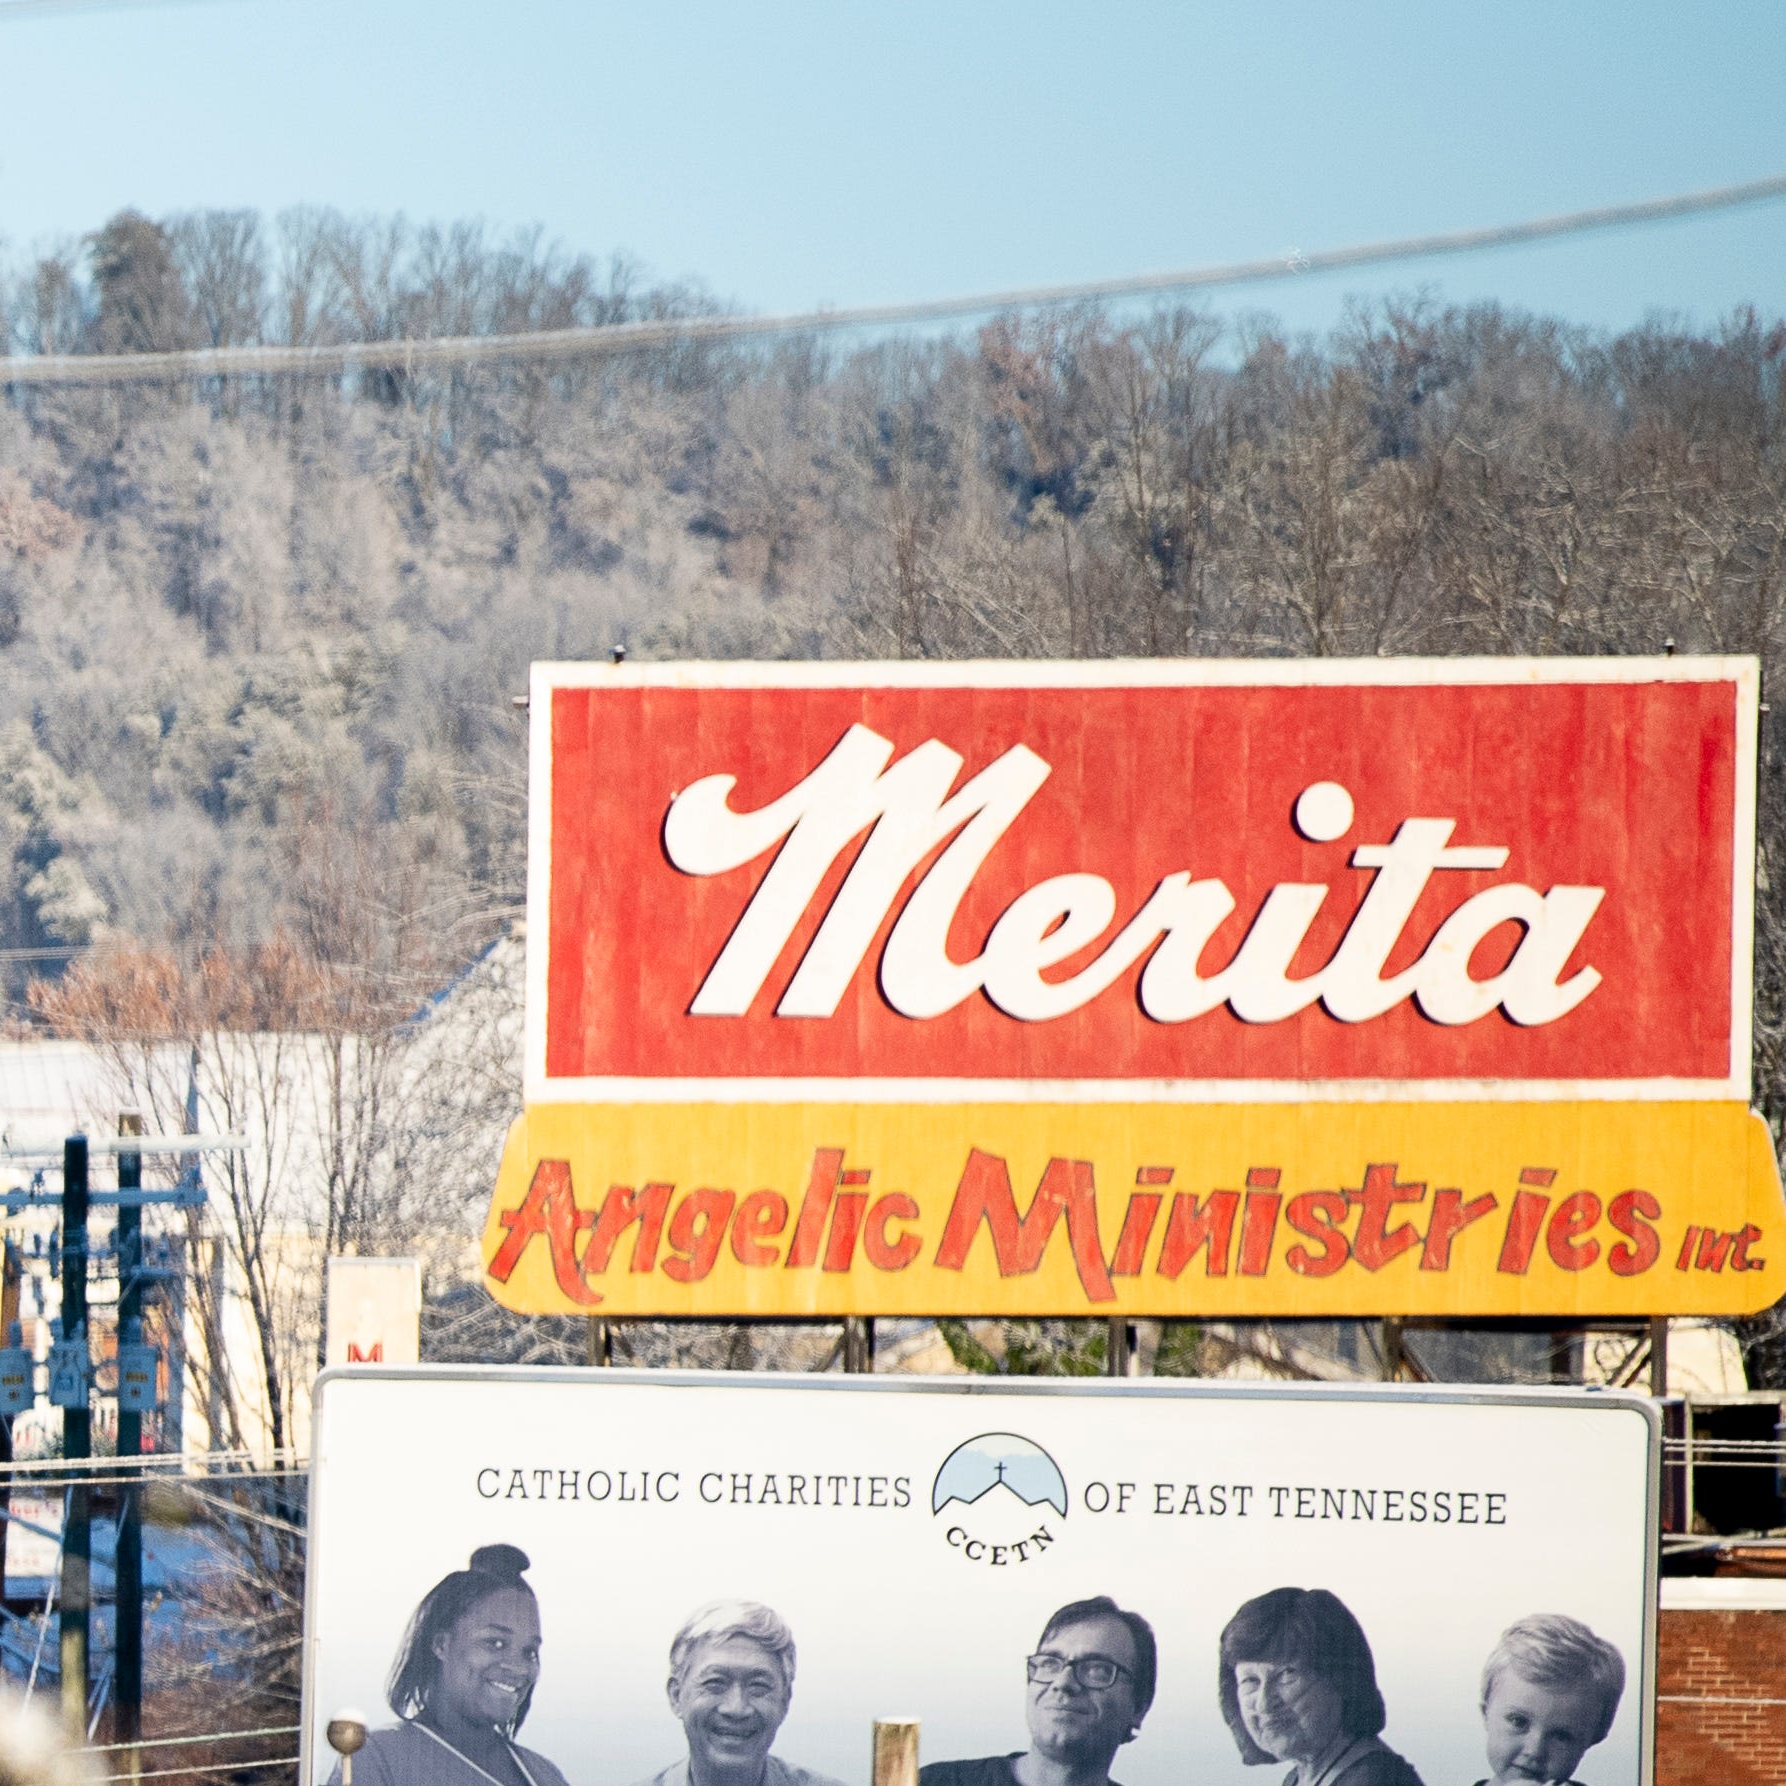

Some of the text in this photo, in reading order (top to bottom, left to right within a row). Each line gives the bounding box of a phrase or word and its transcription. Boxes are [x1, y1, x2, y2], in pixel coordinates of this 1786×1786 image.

[661, 722, 1606, 1026] Merita
[488, 1146, 924, 1307] Angelic
[933, 1146, 1662, 1304] Ministries
[476, 1468, 1508, 1525] CATHOLIC CHARITIES OF EAST TENNESSEE
[946, 1525, 1055, 1567] CCETN
